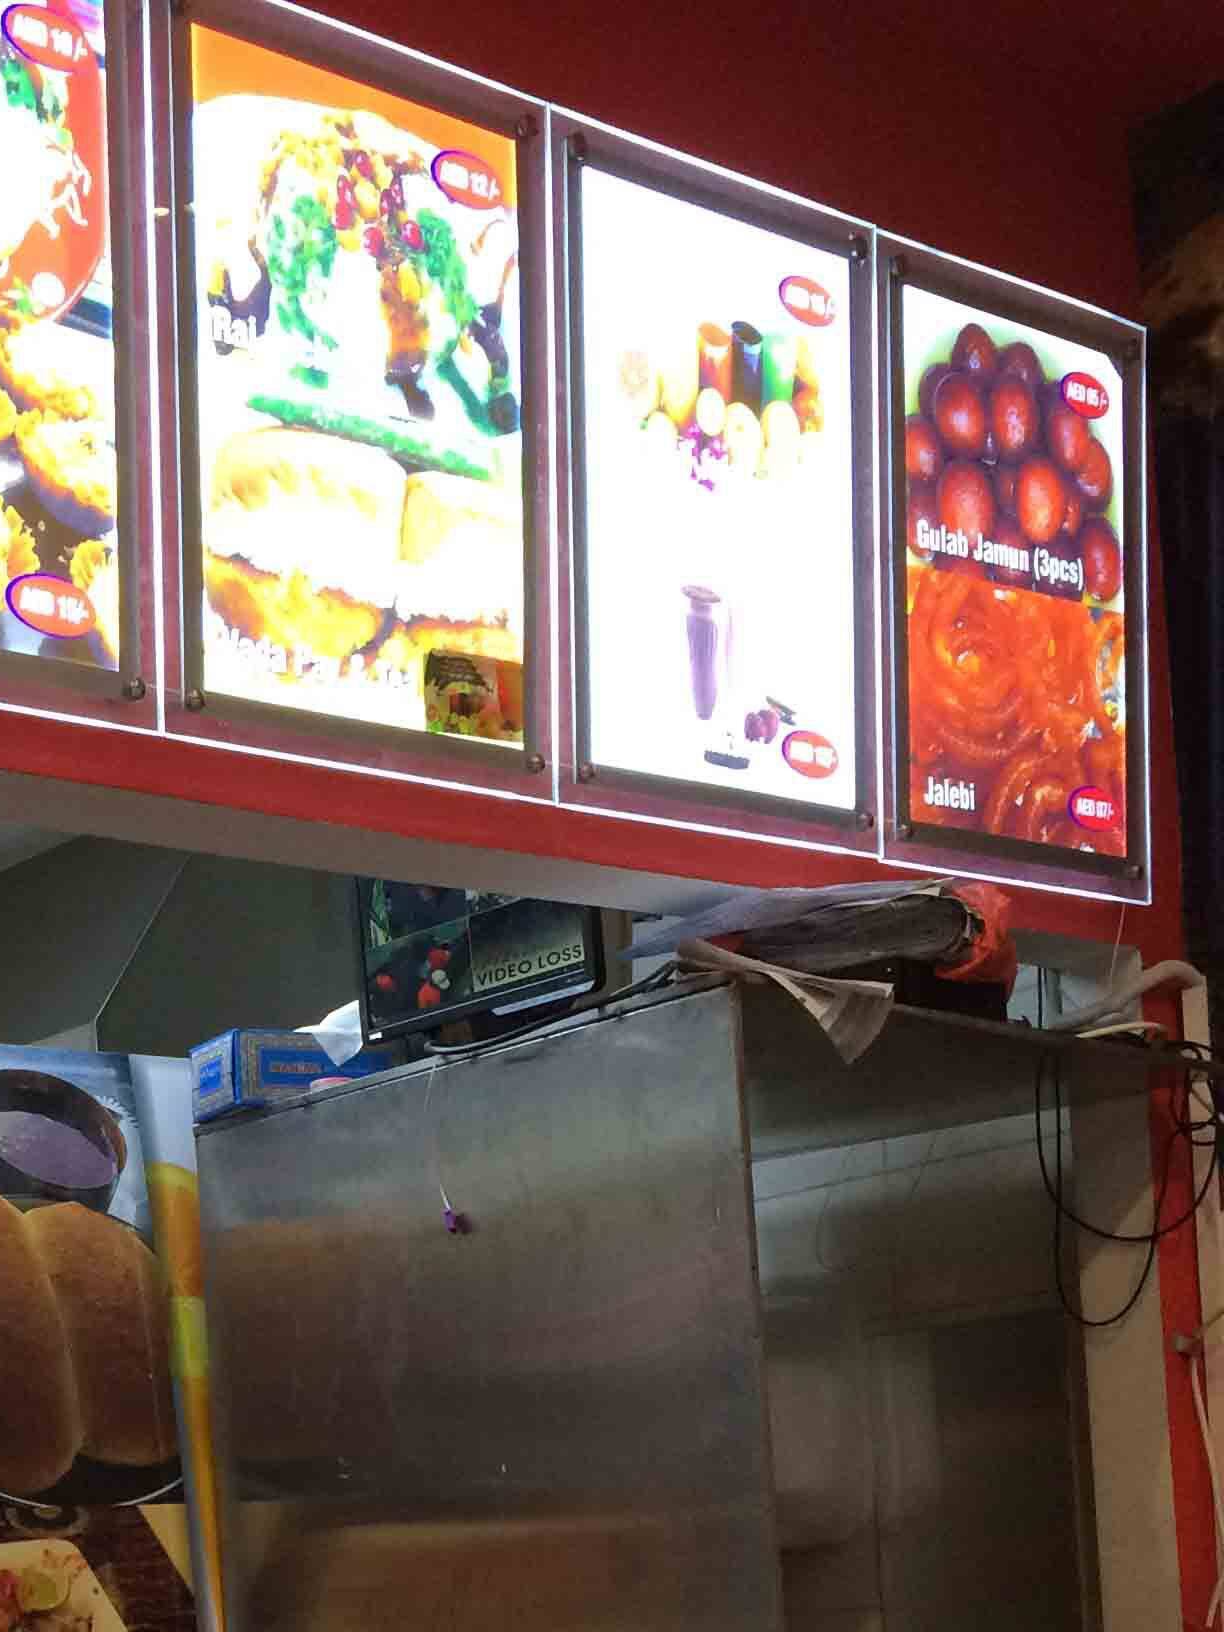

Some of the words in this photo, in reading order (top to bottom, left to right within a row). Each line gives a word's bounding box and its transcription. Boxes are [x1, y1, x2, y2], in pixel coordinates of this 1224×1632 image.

[915, 518, 969, 559] Gulab
[972, 532, 1031, 573] Jamun
[1032, 546, 1085, 592] (3pcs)
[923, 776, 975, 811] Jalebi
[477, 959, 533, 986] VIDEO
[538, 944, 583, 971] LOSS
